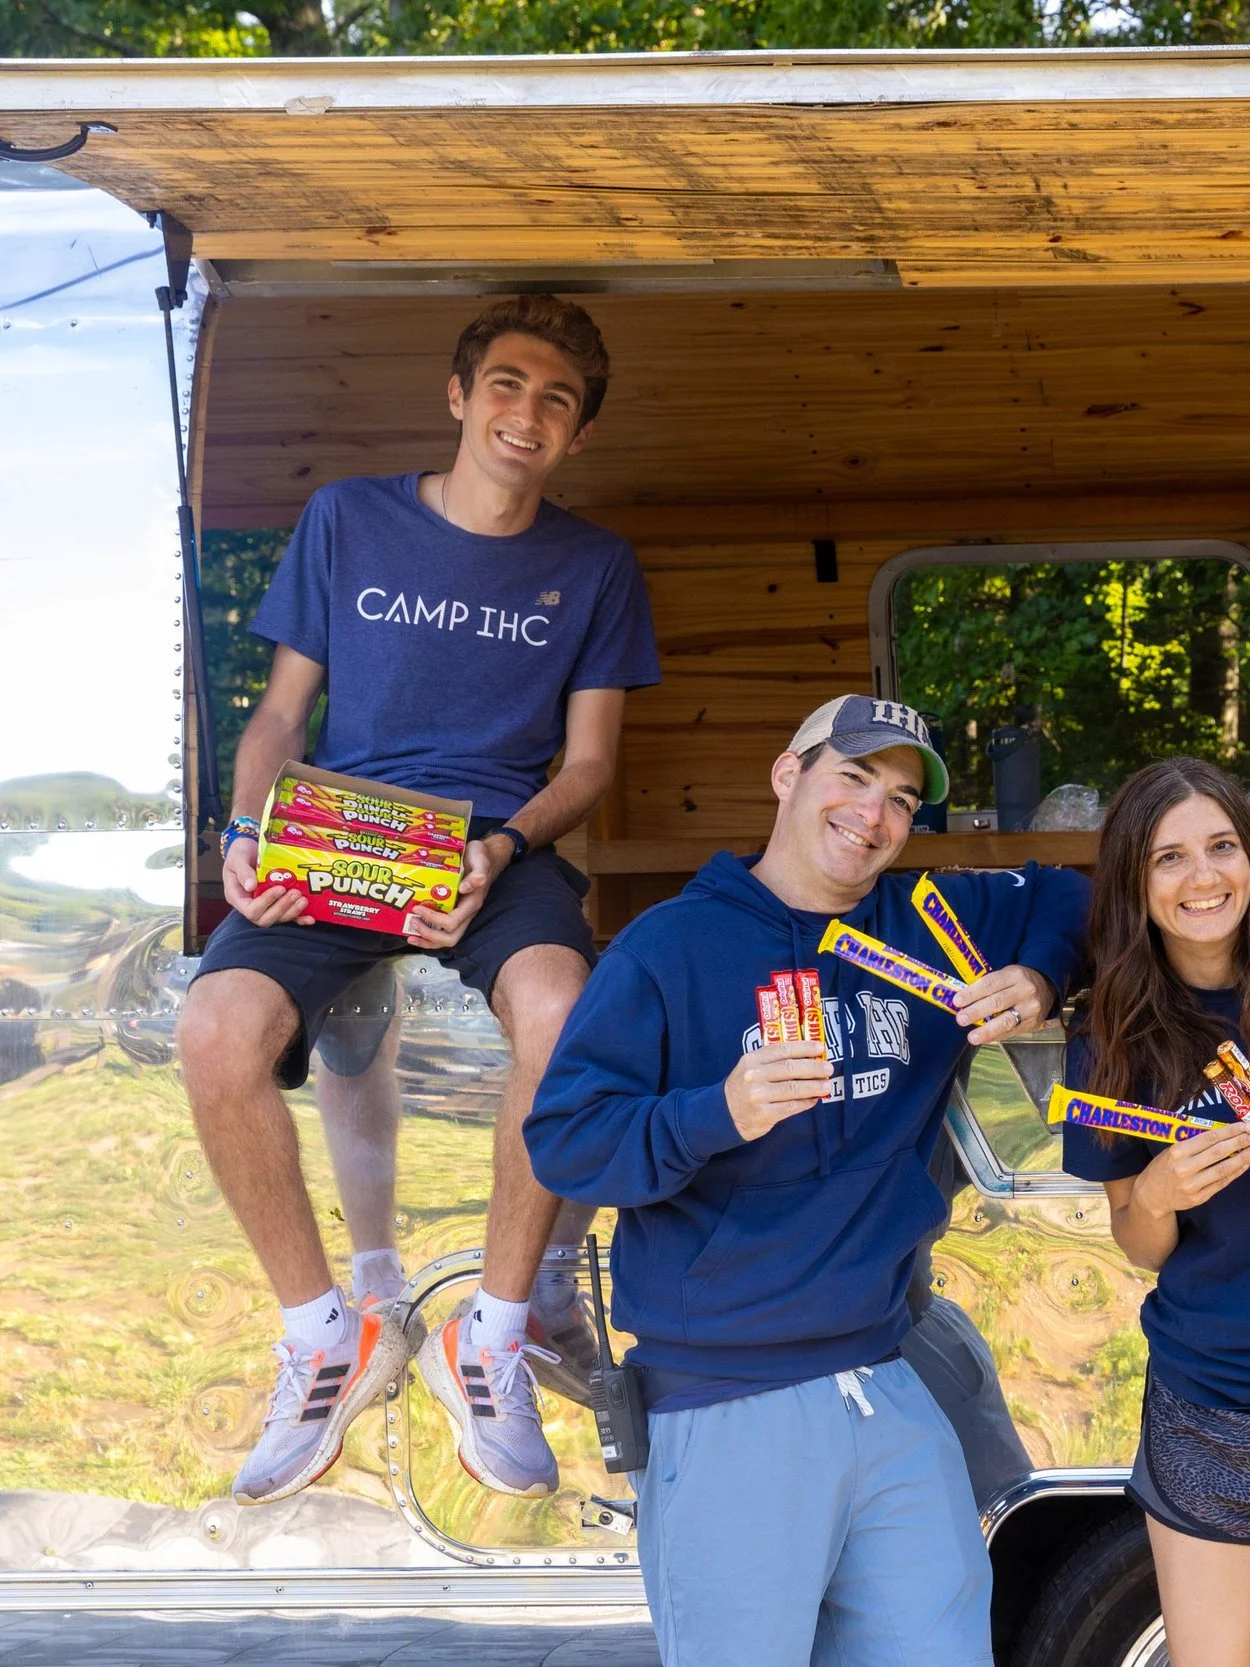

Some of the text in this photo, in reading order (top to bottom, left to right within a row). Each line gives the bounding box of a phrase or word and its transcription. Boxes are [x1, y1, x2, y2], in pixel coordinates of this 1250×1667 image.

[356, 587, 550, 646] CAMP IHC
[341, 810, 409, 833] PUNCH
[333, 838, 401, 860] PUNCH
[347, 832, 385, 848] SOUR
[331, 860, 393, 885] SOUR
[308, 870, 416, 911] PUNCH
[328, 899, 380, 915] STRAWBERRY
[339, 908, 367, 917] STRAWS
[923, 892, 984, 977] CHARLESTON
[834, 933, 932, 994] CHARLESTON
[856, 990, 911, 1066] IHC
[1066, 1098, 1174, 1139] CHARLESTON
